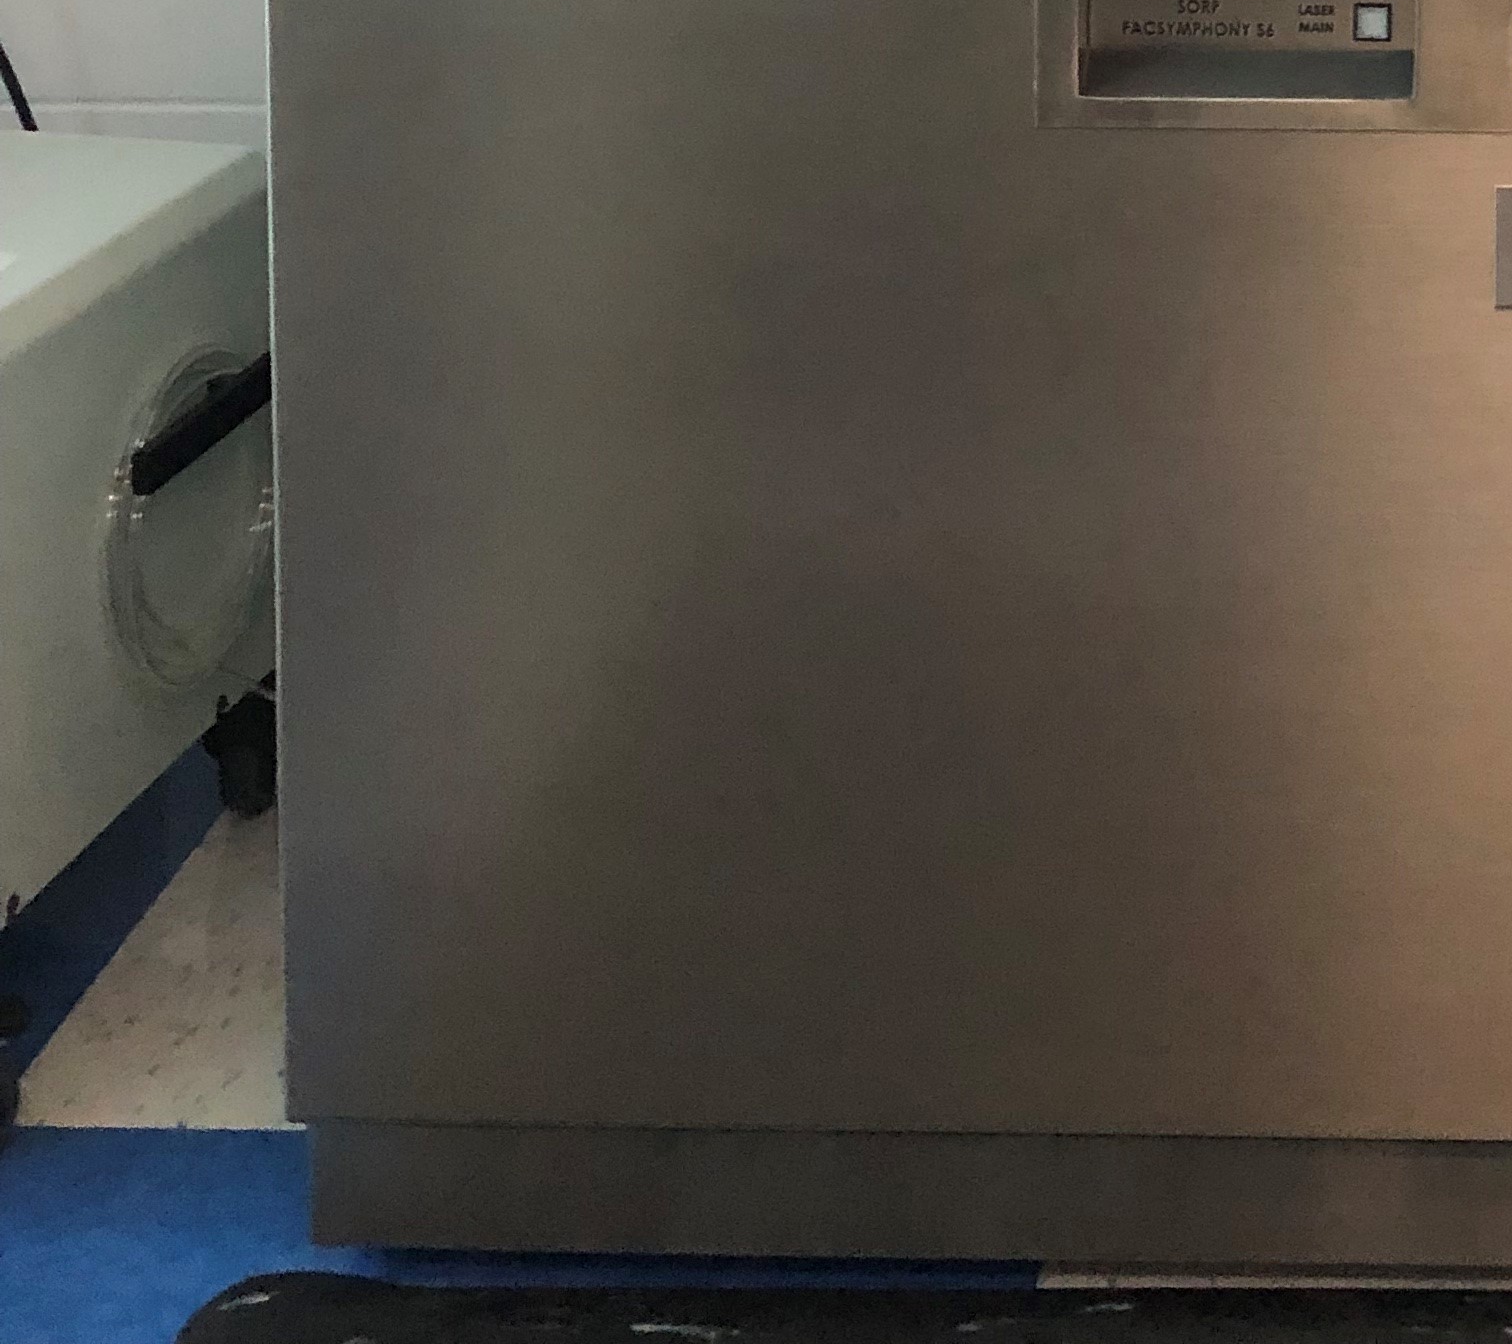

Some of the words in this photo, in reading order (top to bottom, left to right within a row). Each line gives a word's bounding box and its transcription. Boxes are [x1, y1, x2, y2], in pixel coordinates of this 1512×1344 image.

[1177, 0, 1221, 14] SORP
[1298, 3, 1336, 16] LASER
[1121, 20, 1252, 37] FACSYMPHONY
[1298, 21, 1335, 33] MAIN
